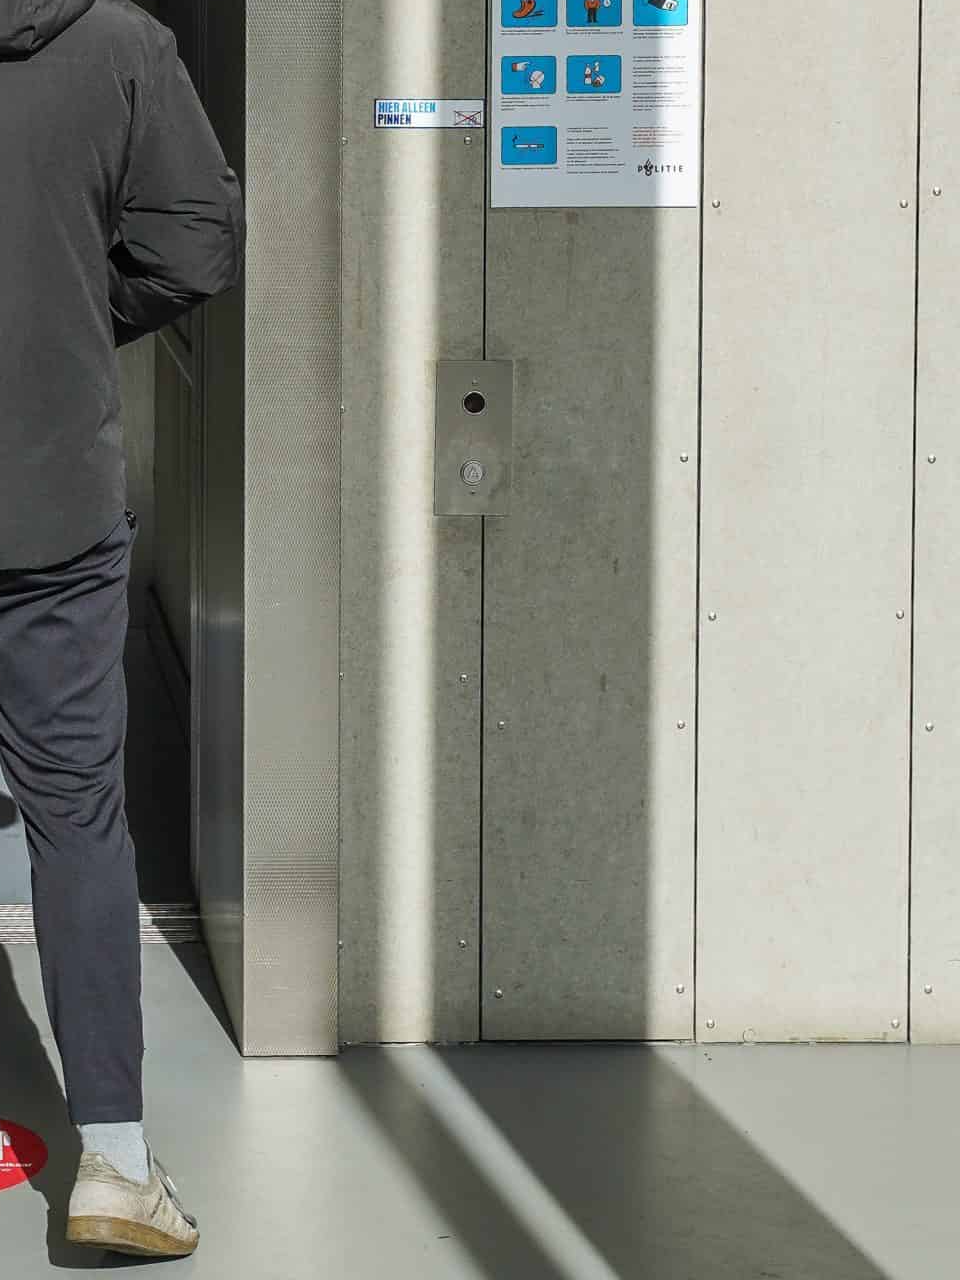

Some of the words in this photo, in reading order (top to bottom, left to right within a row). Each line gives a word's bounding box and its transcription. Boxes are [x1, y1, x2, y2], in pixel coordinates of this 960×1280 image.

[378, 102, 400, 113] HIER
[401, 102, 437, 113] ALLEEN
[377, 114, 412, 125] PINNEN
